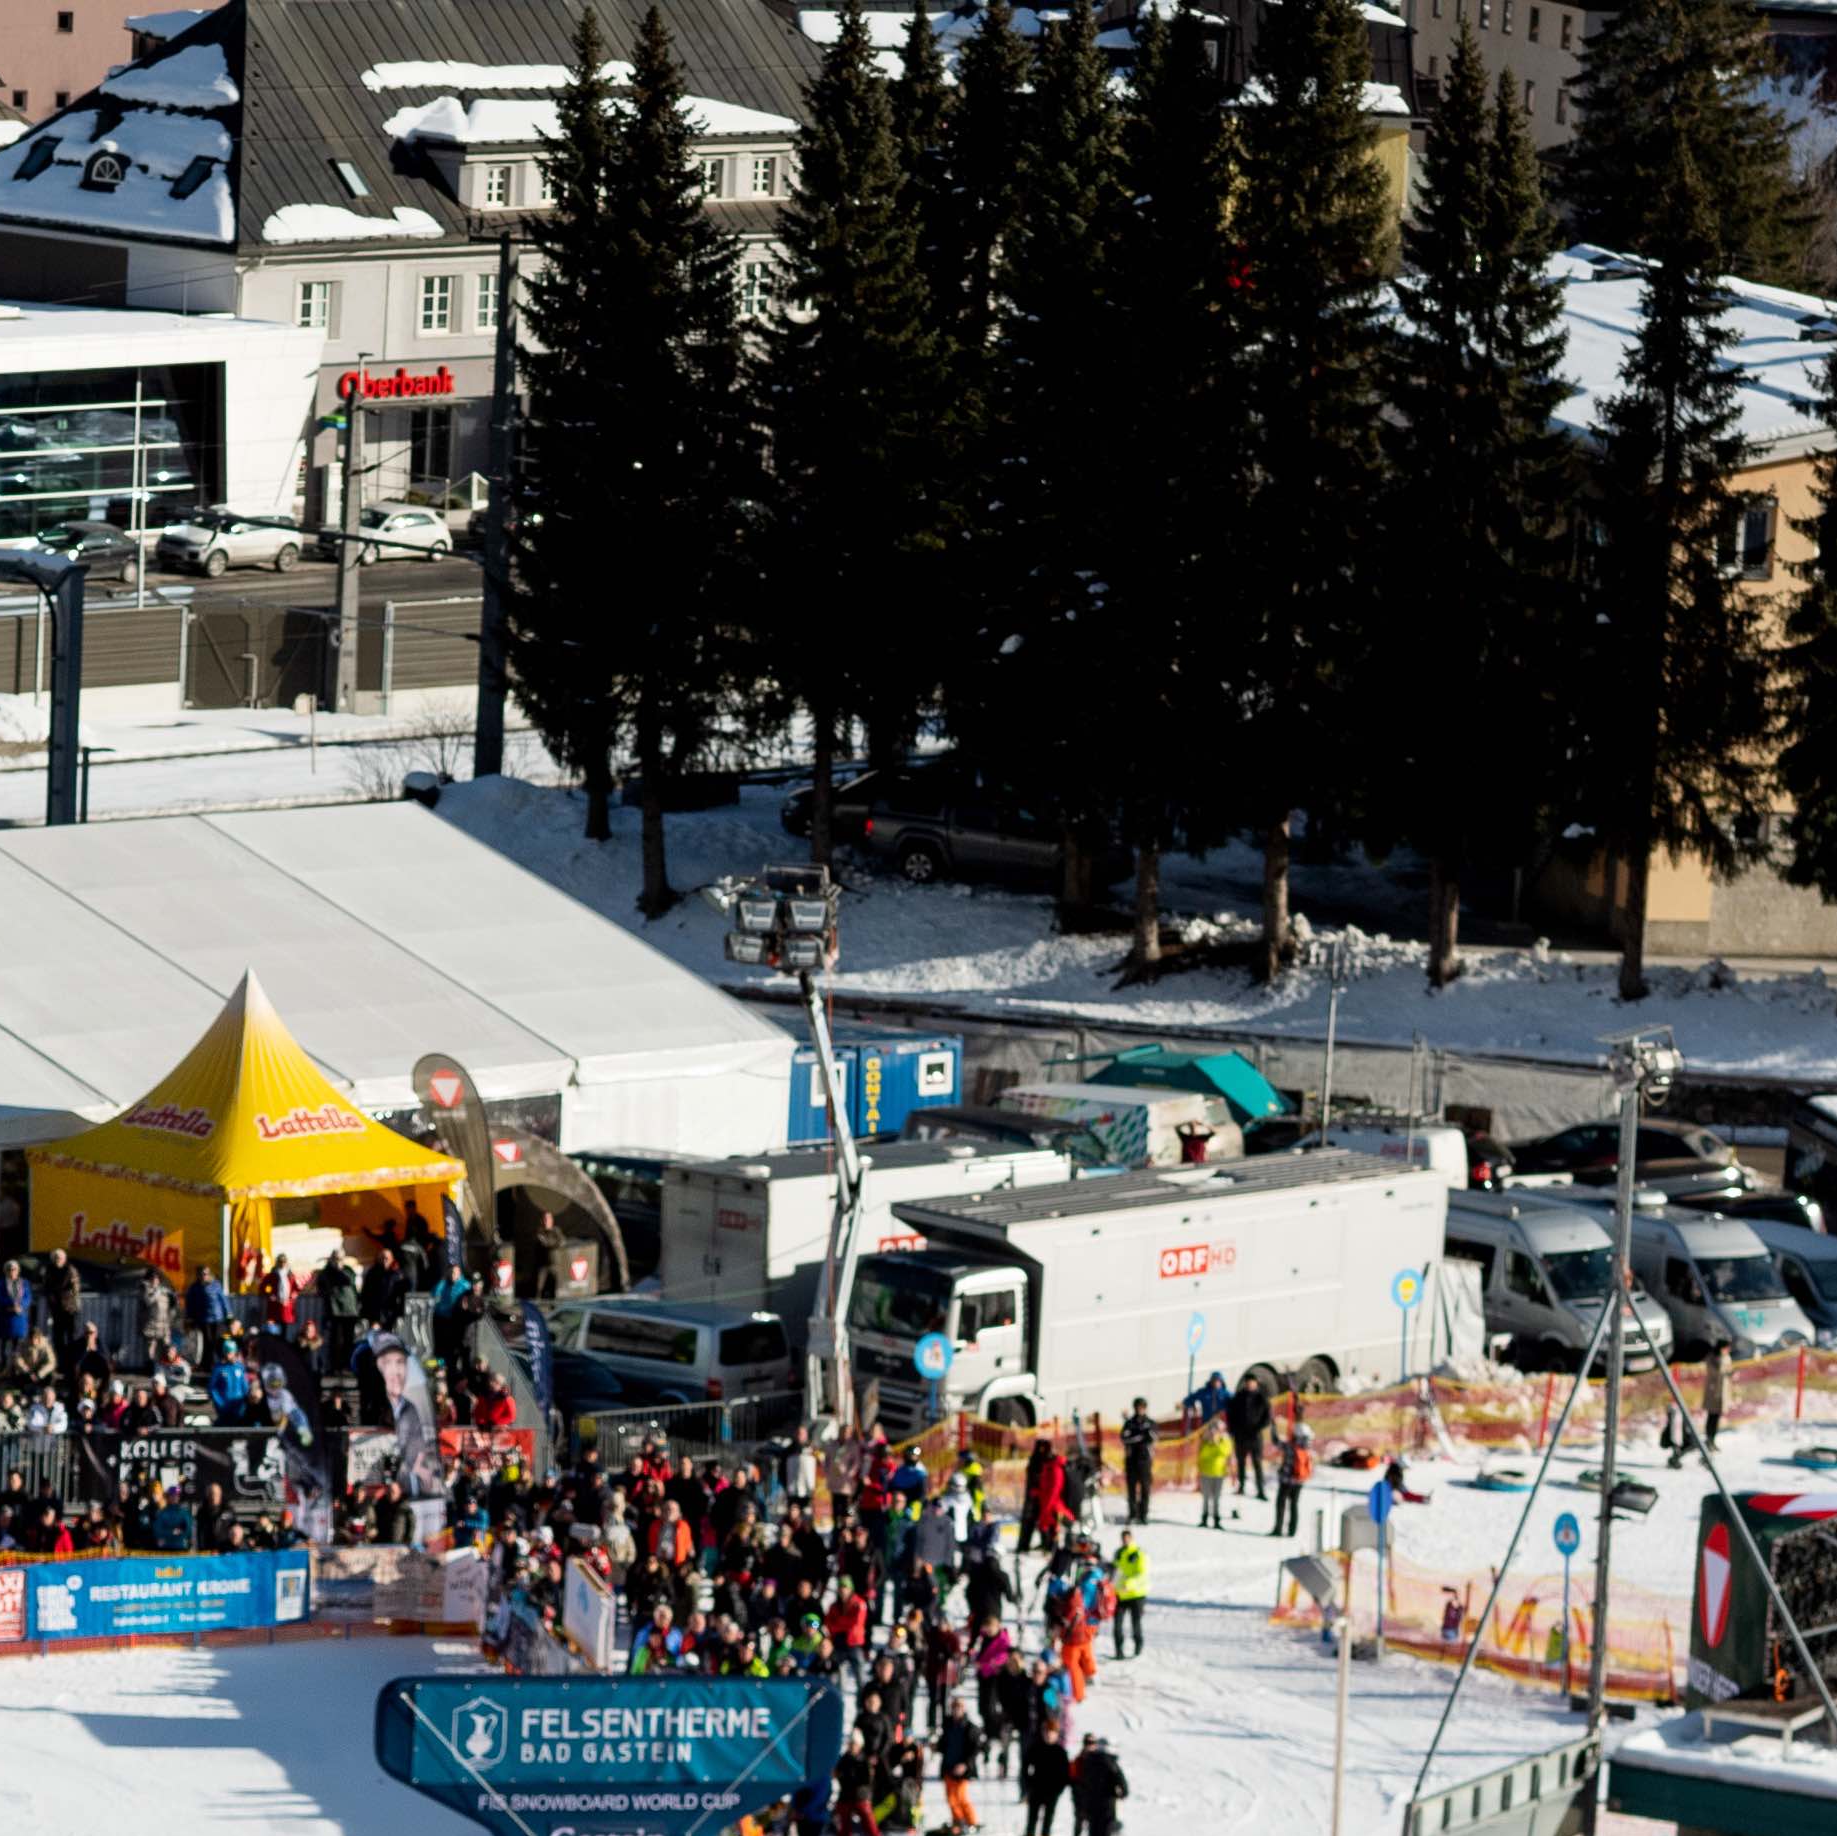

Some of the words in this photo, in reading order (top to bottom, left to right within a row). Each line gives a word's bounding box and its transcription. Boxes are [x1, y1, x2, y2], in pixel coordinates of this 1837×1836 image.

[339, 365, 455, 399] Oberbank
[123, 1102, 215, 1139] Lattella
[257, 1103, 366, 1140] Lattella
[68, 1211, 182, 1272] Lattella
[1161, 1246, 1209, 1276] ORF
[120, 1439, 197, 1460] KOLLER
[89, 1580, 194, 1602] RESTAURANT
[196, 1577, 251, 1596] KRONE
[520, 1706, 771, 1740] FELSENTHERME
[520, 1742, 572, 1764] BAD
[582, 1742, 693, 1764] GASTEIN
[477, 1793, 508, 1812] FIS
[511, 1793, 630, 1813] SNOWBOARD
[631, 1793, 699, 1812] WORLD
[700, 1792, 741, 1811] CUP
